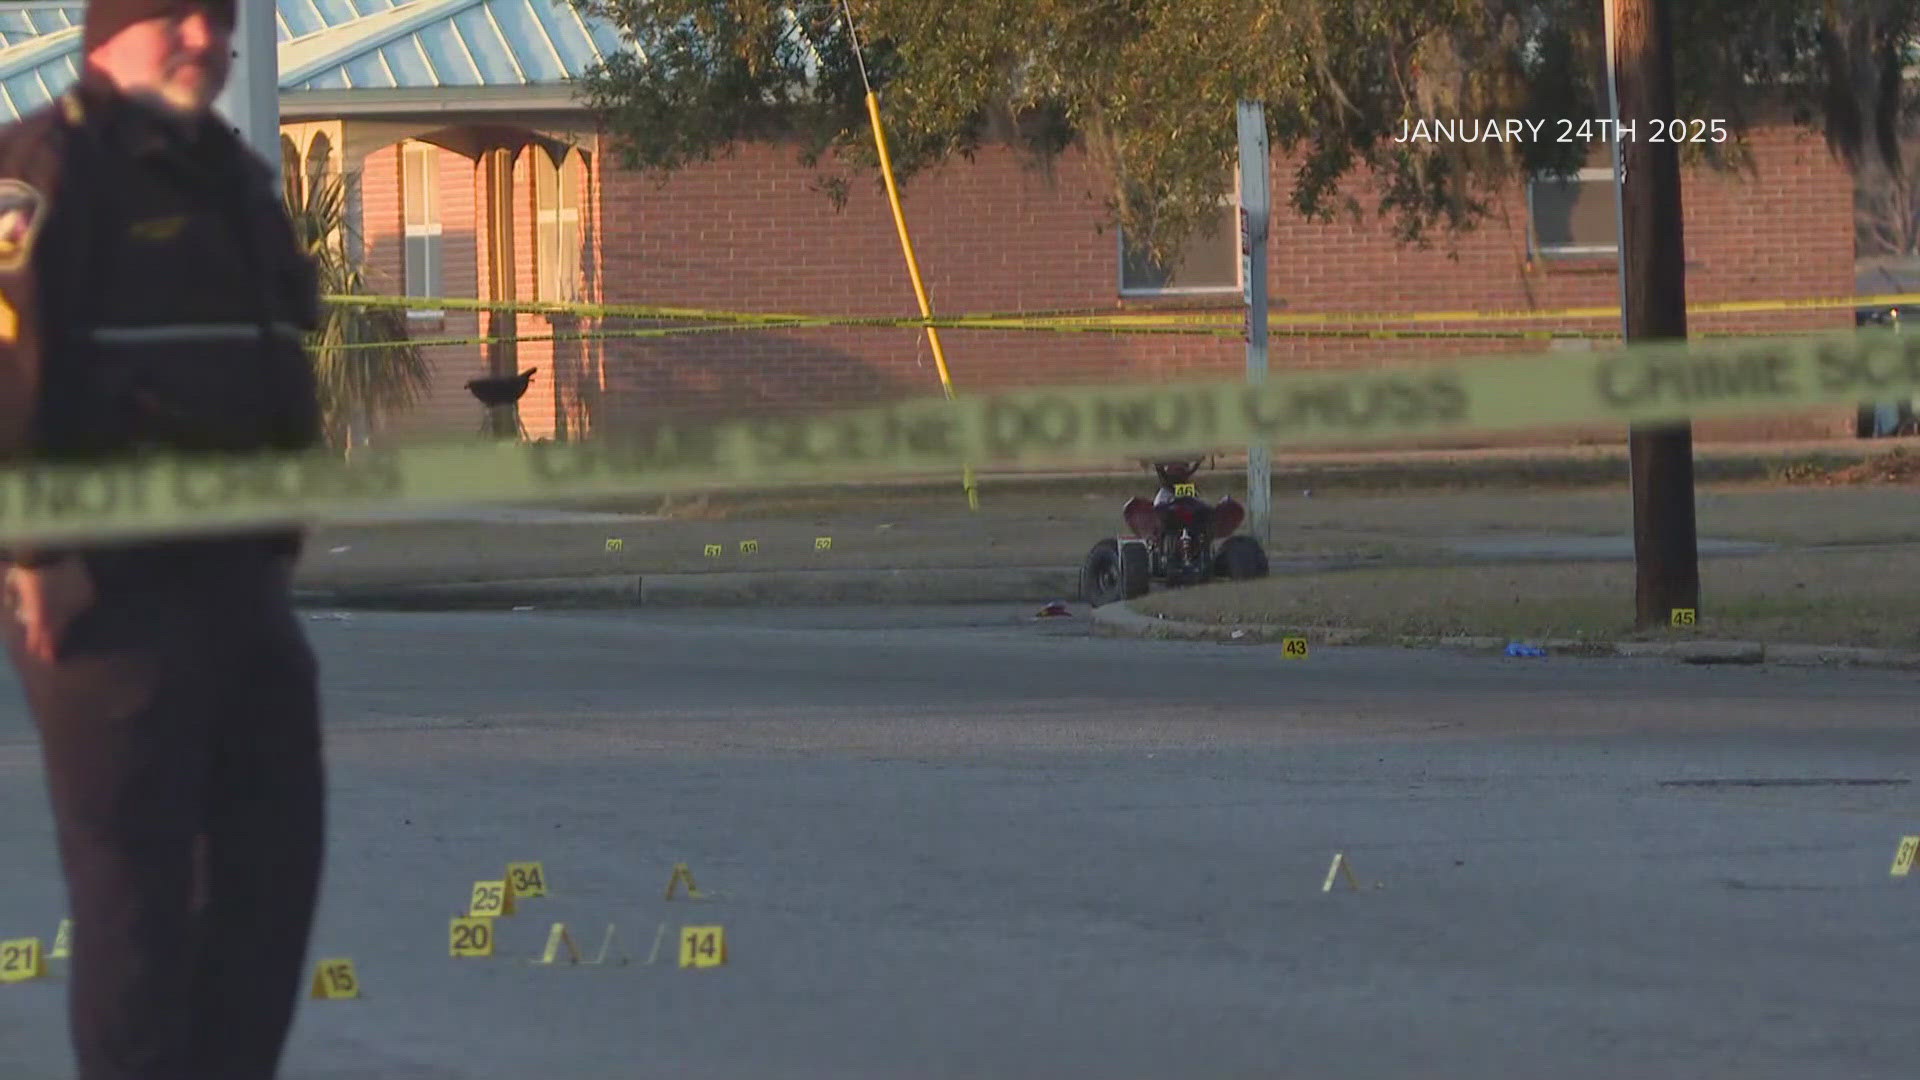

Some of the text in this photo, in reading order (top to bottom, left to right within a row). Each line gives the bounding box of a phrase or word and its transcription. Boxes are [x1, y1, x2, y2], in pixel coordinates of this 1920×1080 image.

[982, 392, 1083, 456] DO
[1093, 386, 1216, 443] NOT
[1239, 371, 1468, 438] CROSS
[1592, 342, 1796, 409] CRIME
[1672, 611, 1693, 625] 45
[1286, 640, 1306, 655] 43
[512, 868, 543, 892] 34
[472, 886, 502, 911] 25
[452, 923, 489, 950] 20
[687, 931, 716, 959] 14
[3, 944, 33, 972] 21
[326, 964, 354, 992] 15
